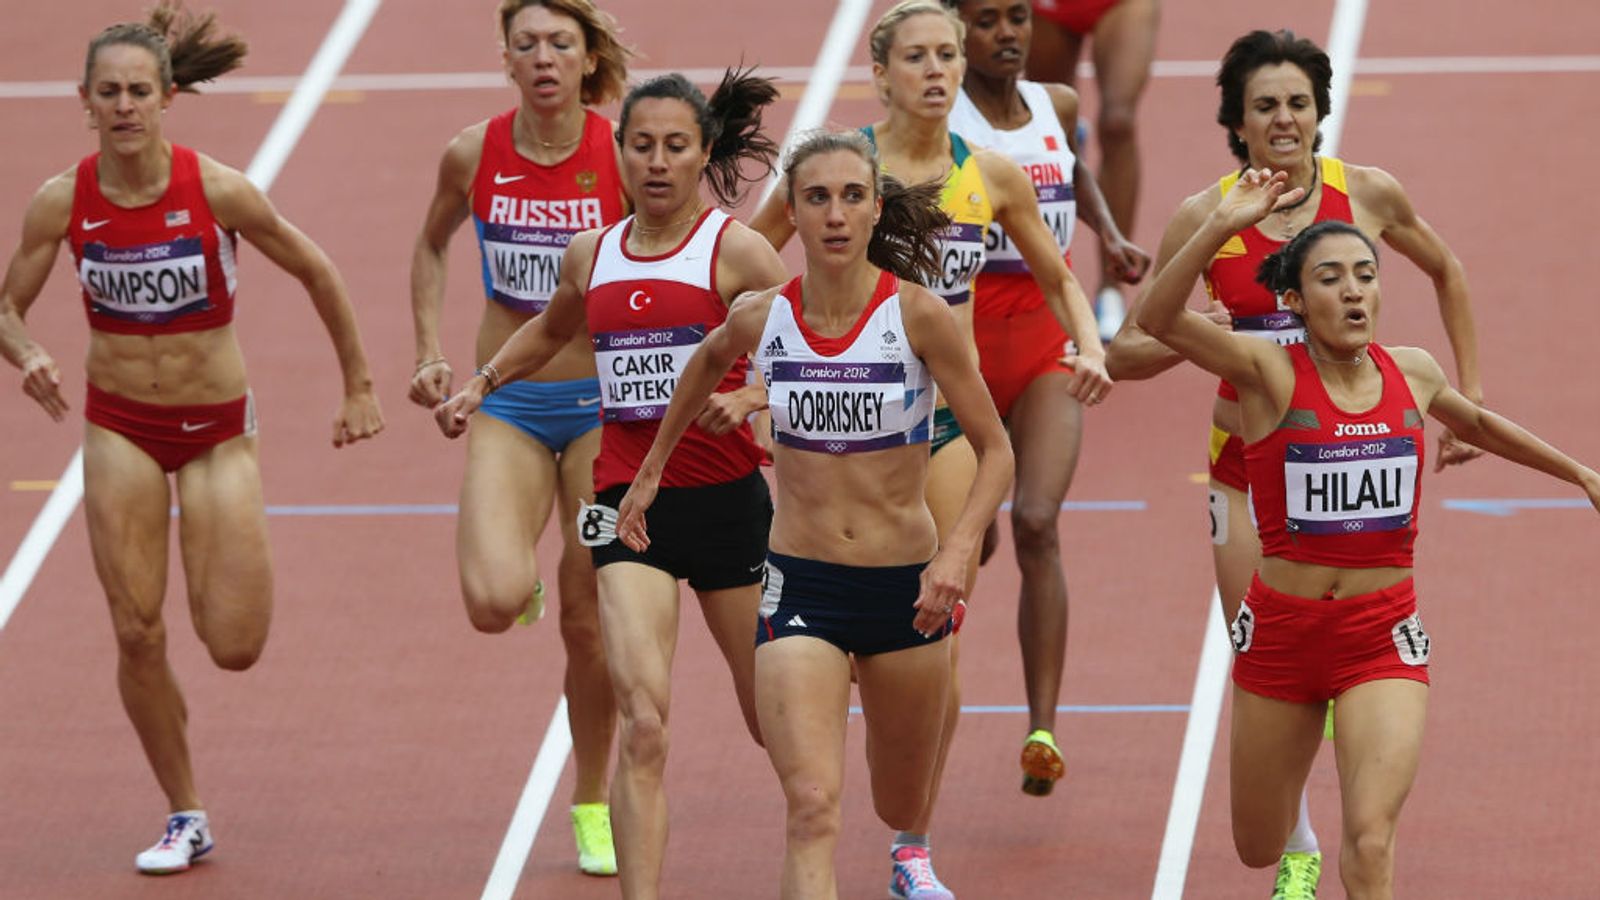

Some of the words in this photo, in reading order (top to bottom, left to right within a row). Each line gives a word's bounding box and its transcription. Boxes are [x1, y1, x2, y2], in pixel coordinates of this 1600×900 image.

[488, 194, 602, 230] RUSSIA
[511, 230, 552, 244] London
[103, 250, 143, 262] London
[144, 245, 171, 259] 2012
[87, 265, 200, 305] SIMPSON
[609, 334, 646, 347] London
[648, 331, 674, 344] 2012
[612, 352, 675, 378] CAKIR
[800, 366, 841, 379] London
[843, 367, 871, 379] 2012
[788, 389, 885, 433] DOBRISKEY
[1318, 447, 1360, 460] London
[1362, 442, 1387, 456] 2012
[1305, 467, 1402, 513] HILALI
[582, 508, 604, 541] 8
